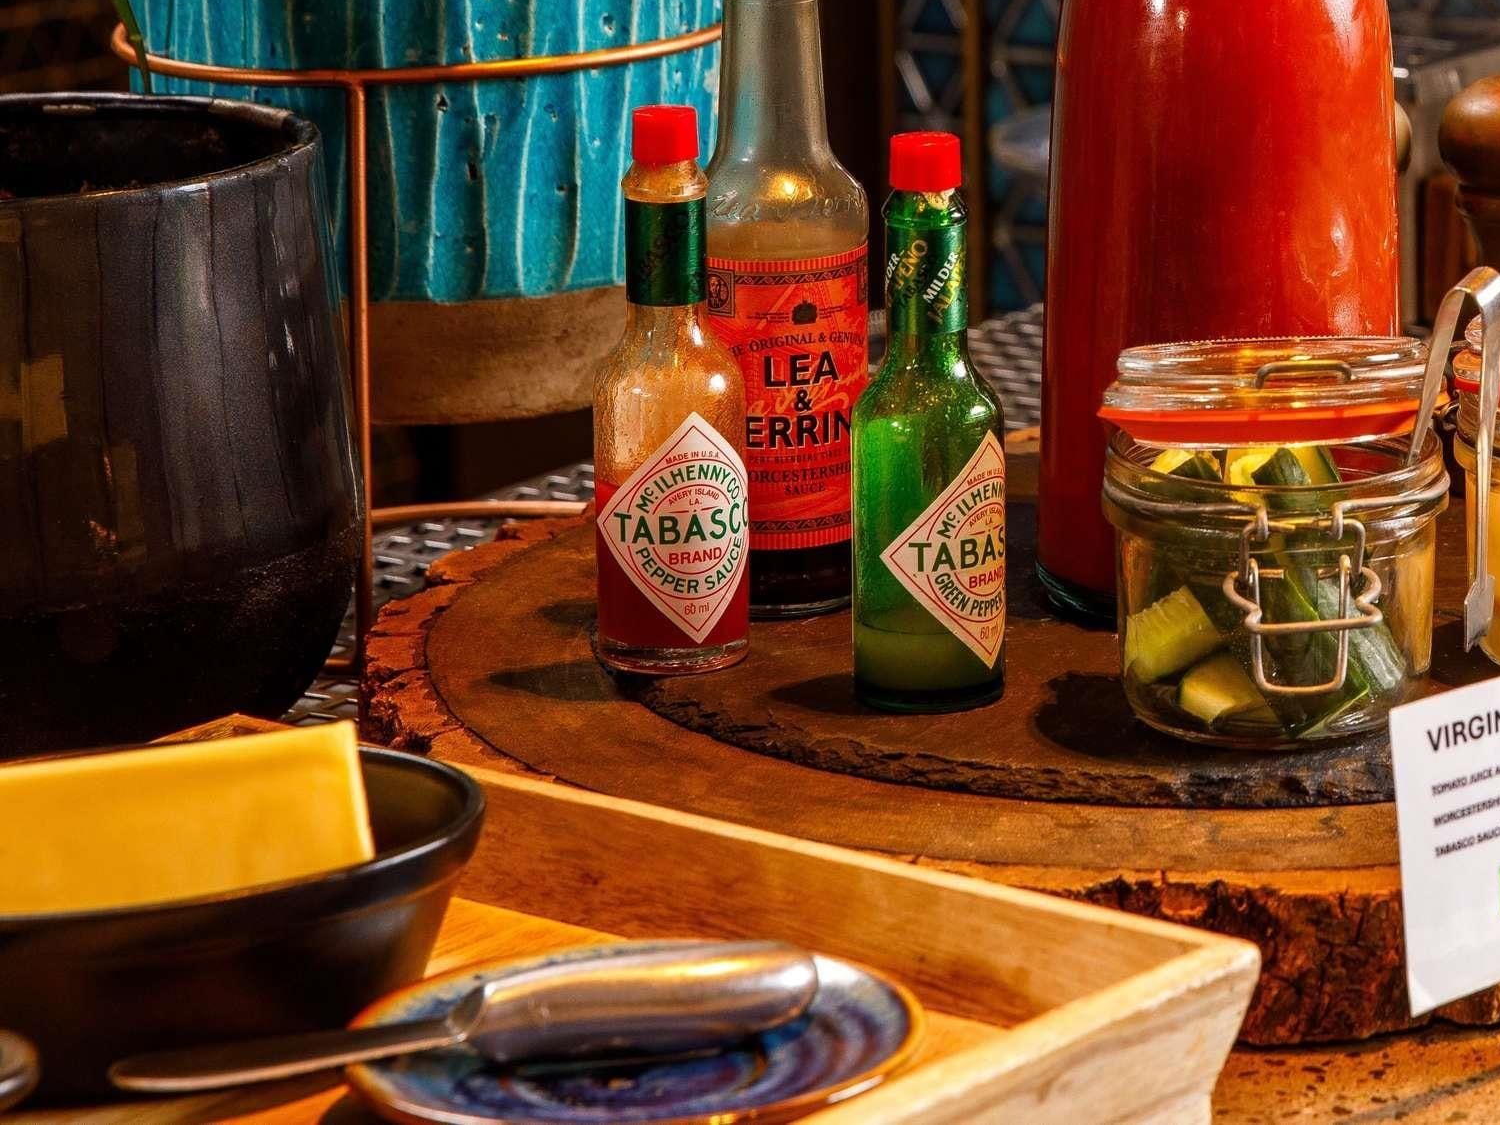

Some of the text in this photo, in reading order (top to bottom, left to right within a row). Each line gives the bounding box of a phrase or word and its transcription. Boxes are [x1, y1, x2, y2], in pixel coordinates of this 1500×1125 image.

[922, 251, 959, 303] MILDER
[749, 333, 816, 352] ORIGINAL
[818, 332, 827, 343] &
[763, 350, 841, 388] LEA
[793, 387, 812, 413] &
[745, 410, 851, 450] ERRIN
[665, 452, 689, 465] MADE
[748, 461, 851, 484] ORCESTERSHI
[967, 471, 986, 486] MADE
[668, 488, 720, 507] AVERY ISLAND
[784, 481, 826, 495] SAUCE
[969, 507, 989, 527] AVERY
[668, 546, 722, 566] BRAND
[908, 526, 1005, 573] TABAS
[635, 536, 742, 594] PEPPER SAUCE
[934, 572, 971, 612] GREEN
[684, 602, 710, 615] 60 ml
[980, 626, 990, 640] 60
[1431, 775, 1468, 796] TOMATO
[1469, 768, 1493, 785] JUICE
[1435, 834, 1475, 857] TABASCO
